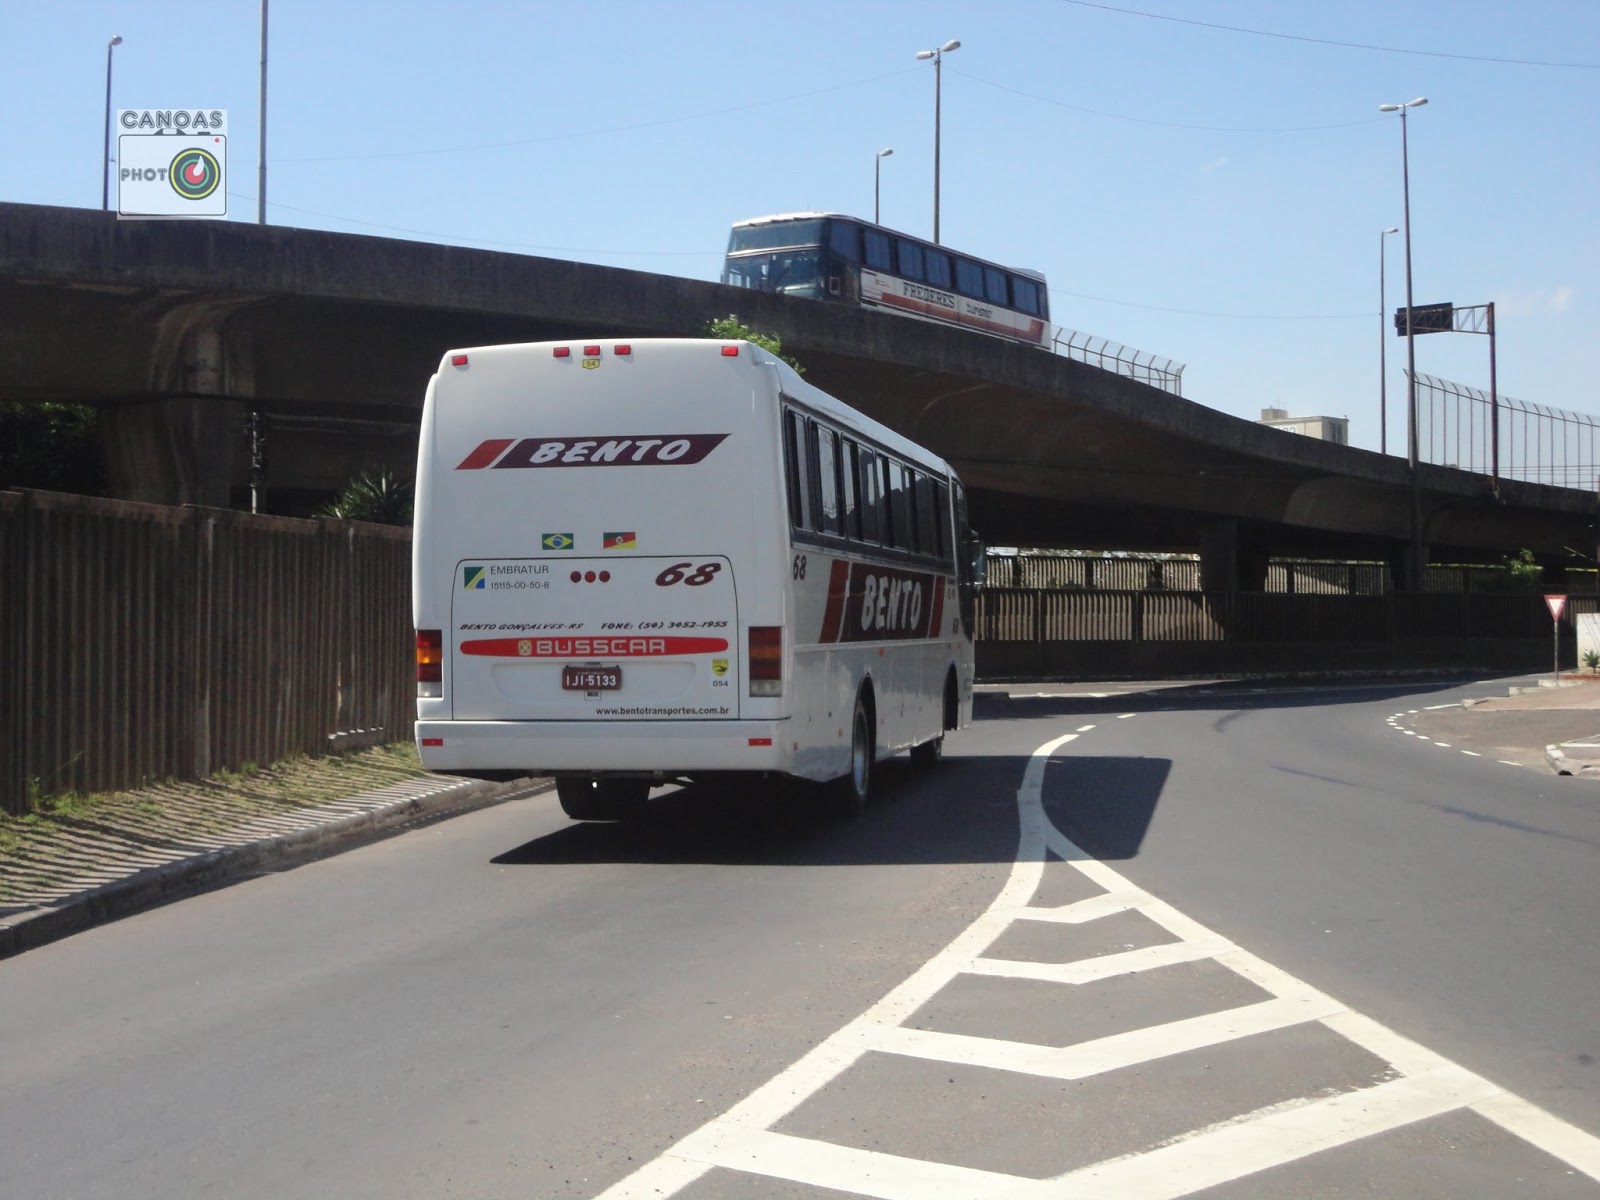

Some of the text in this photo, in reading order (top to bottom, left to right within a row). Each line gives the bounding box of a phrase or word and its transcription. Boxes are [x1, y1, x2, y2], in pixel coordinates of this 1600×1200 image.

[903, 282, 955, 308] FREDERES
[529, 439, 691, 464] BENTO
[490, 565, 549, 575] EMBRATUR
[655, 562, 722, 587] 68
[792, 554, 807, 581] 68
[861, 574, 922, 631] BENTO
[638, 621, 664, 629] (54)
[536, 639, 666, 654] BUSSCAR
[596, 706, 729, 716] www.bentotransportes.com.br
